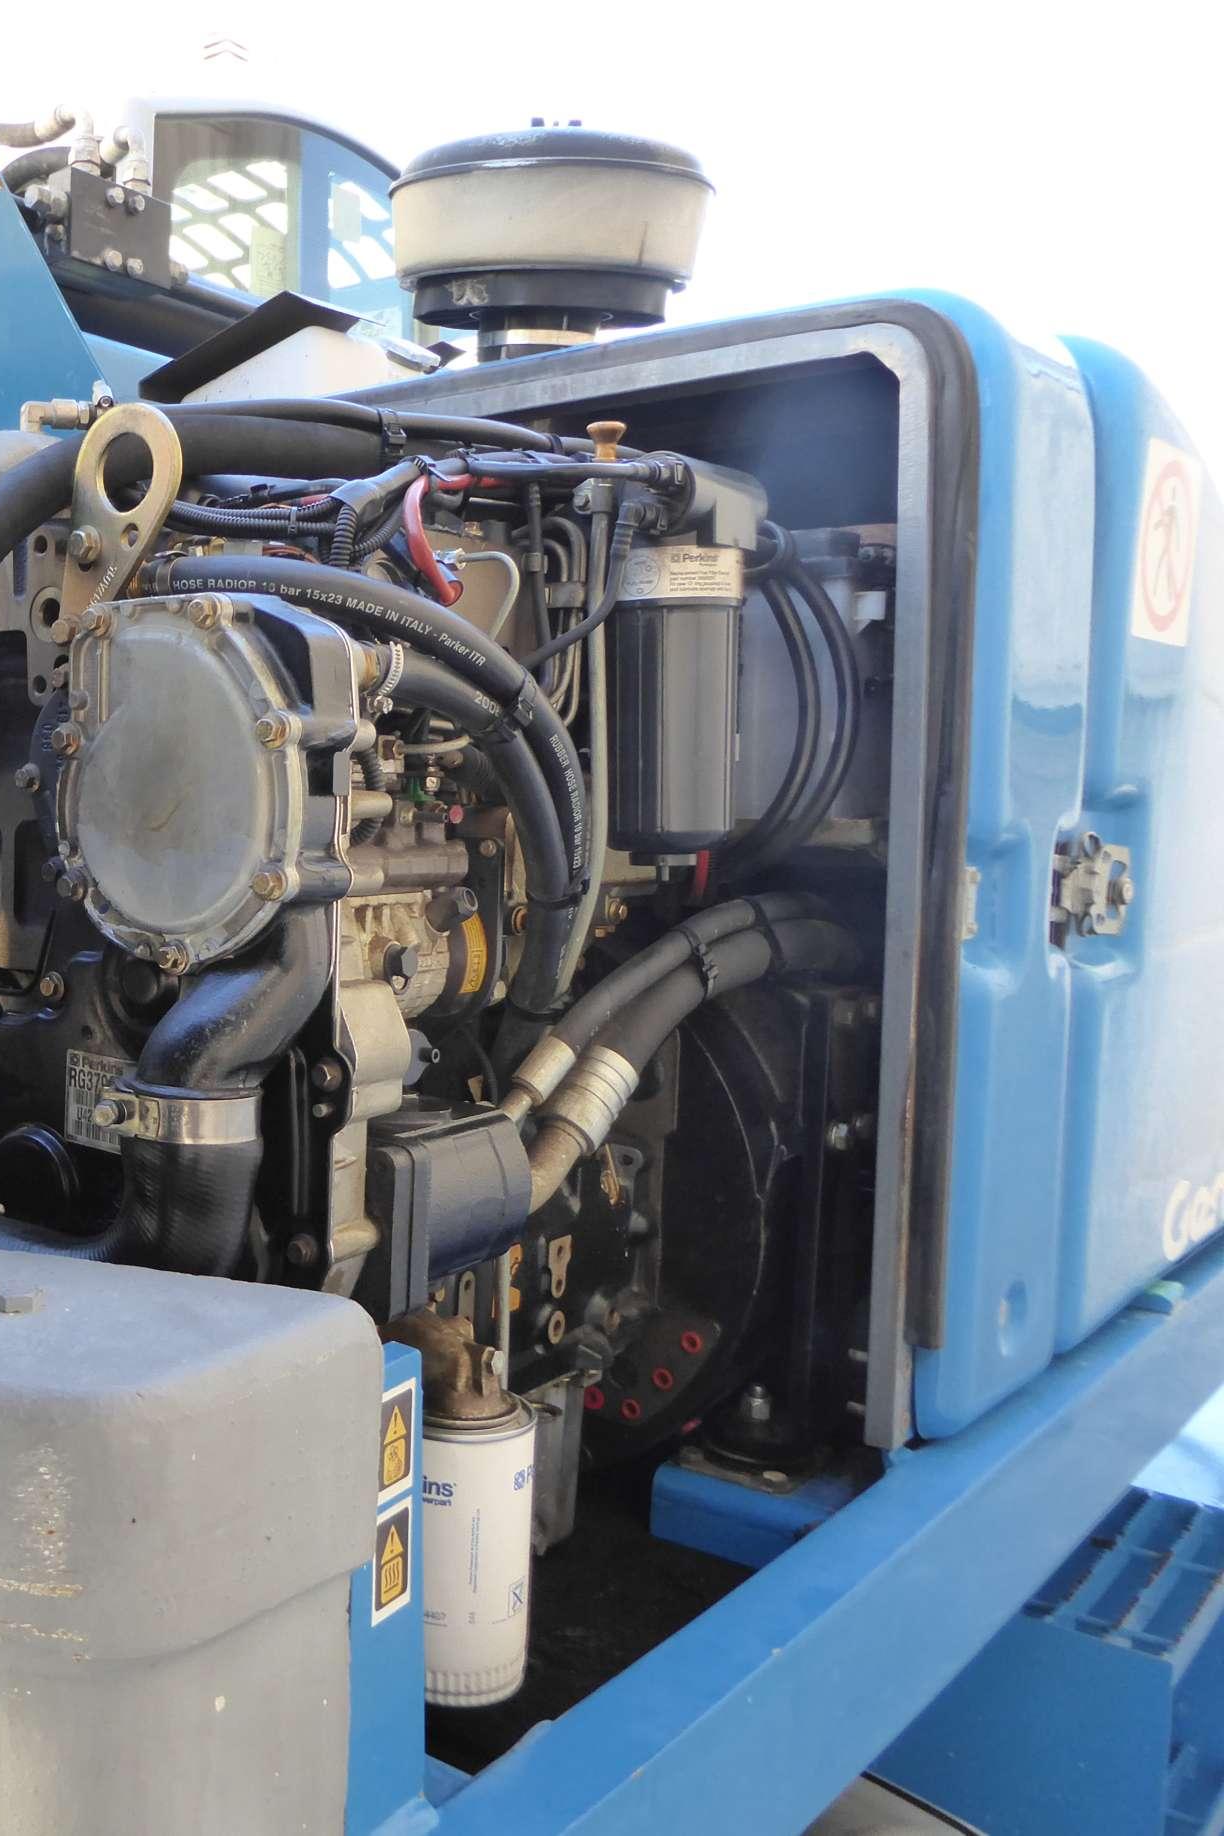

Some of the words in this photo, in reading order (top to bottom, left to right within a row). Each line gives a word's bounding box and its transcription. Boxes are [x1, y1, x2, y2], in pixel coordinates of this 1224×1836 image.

[682, 553, 721, 562] Perkins
[172, 578, 204, 591] HOSE
[207, 578, 257, 590] RADIOR
[279, 584, 302, 597] bar
[305, 588, 343, 604] 15x23
[345, 597, 385, 617] MADE
[384, 609, 400, 623] IN
[400, 615, 433, 636] ITALY
[438, 633, 469, 656] Parker
[467, 650, 488, 667] ITR
[548, 734, 569, 768] RUBBER
[563, 768, 577, 793] HOSE
[82, 1055, 124, 1077] Perkins
